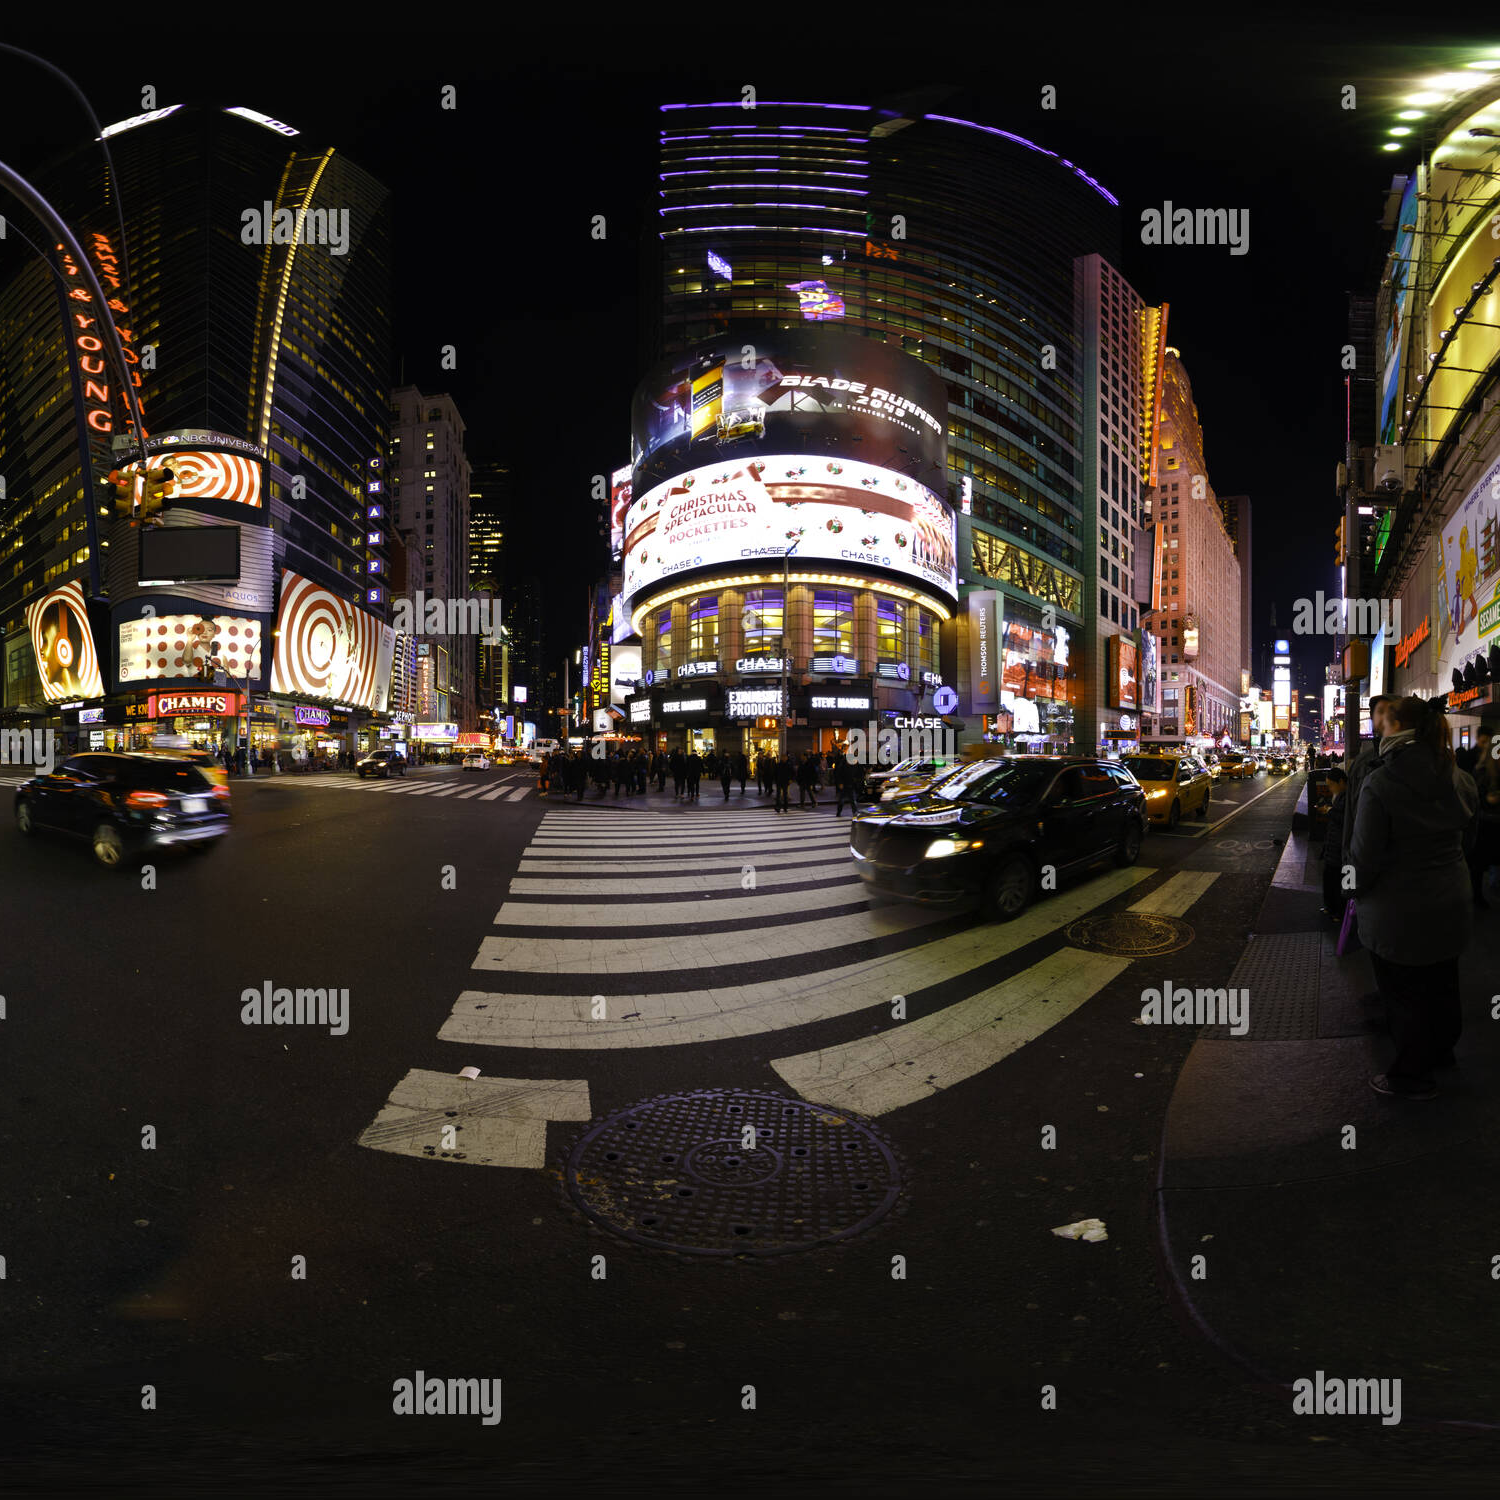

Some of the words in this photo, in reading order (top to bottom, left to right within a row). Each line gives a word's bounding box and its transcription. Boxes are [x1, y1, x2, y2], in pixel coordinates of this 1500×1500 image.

[75, 314, 113, 432] YOUNG
[779, 375, 868, 394] BLADE
[870, 387, 942, 436] RUNNER
[855, 395, 906, 418] 2049
[180, 434, 266, 456] NBCUNIVERSAL
[670, 490, 747, 519] CHRISTMAS
[664, 502, 757, 536] SPECTACULAR
[368, 457, 381, 602] CHAMPS
[669, 518, 749, 545] ROCKETTES
[741, 546, 786, 557] CHASE
[841, 549, 881, 564] CHASE
[662, 559, 692, 575] CHASE
[922, 570, 943, 588] CHASE
[225, 591, 259, 602] AQUOS
[1395, 615, 1429, 670] Walgreens
[601, 642, 609, 674] VICTORY
[980, 642, 988, 677] THOMSON
[677, 661, 718, 677] CHASE
[601, 677, 609, 693] NEW
[126, 704, 137, 716] WE
[158, 695, 227, 714] CHAMPS
[811, 696, 837, 708] STEVE
[894, 717, 942, 729] CHASE
